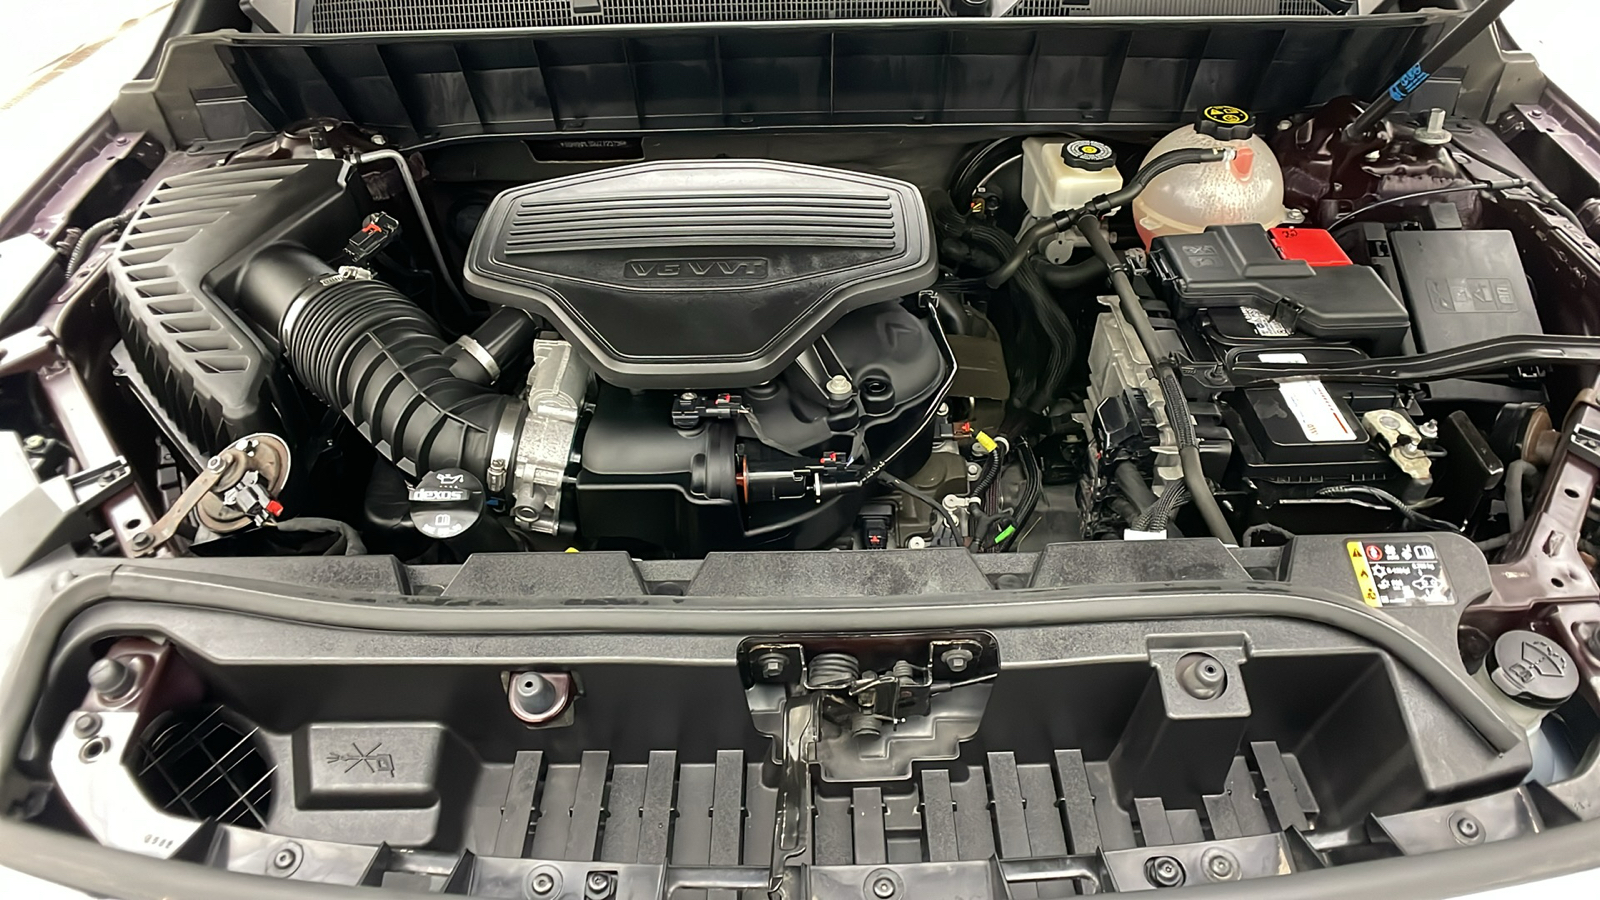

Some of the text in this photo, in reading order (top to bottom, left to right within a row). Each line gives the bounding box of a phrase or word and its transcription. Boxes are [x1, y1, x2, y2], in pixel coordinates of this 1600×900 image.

[630, 260, 767, 276] V6 VVT
[413, 488, 463, 501] dexos
